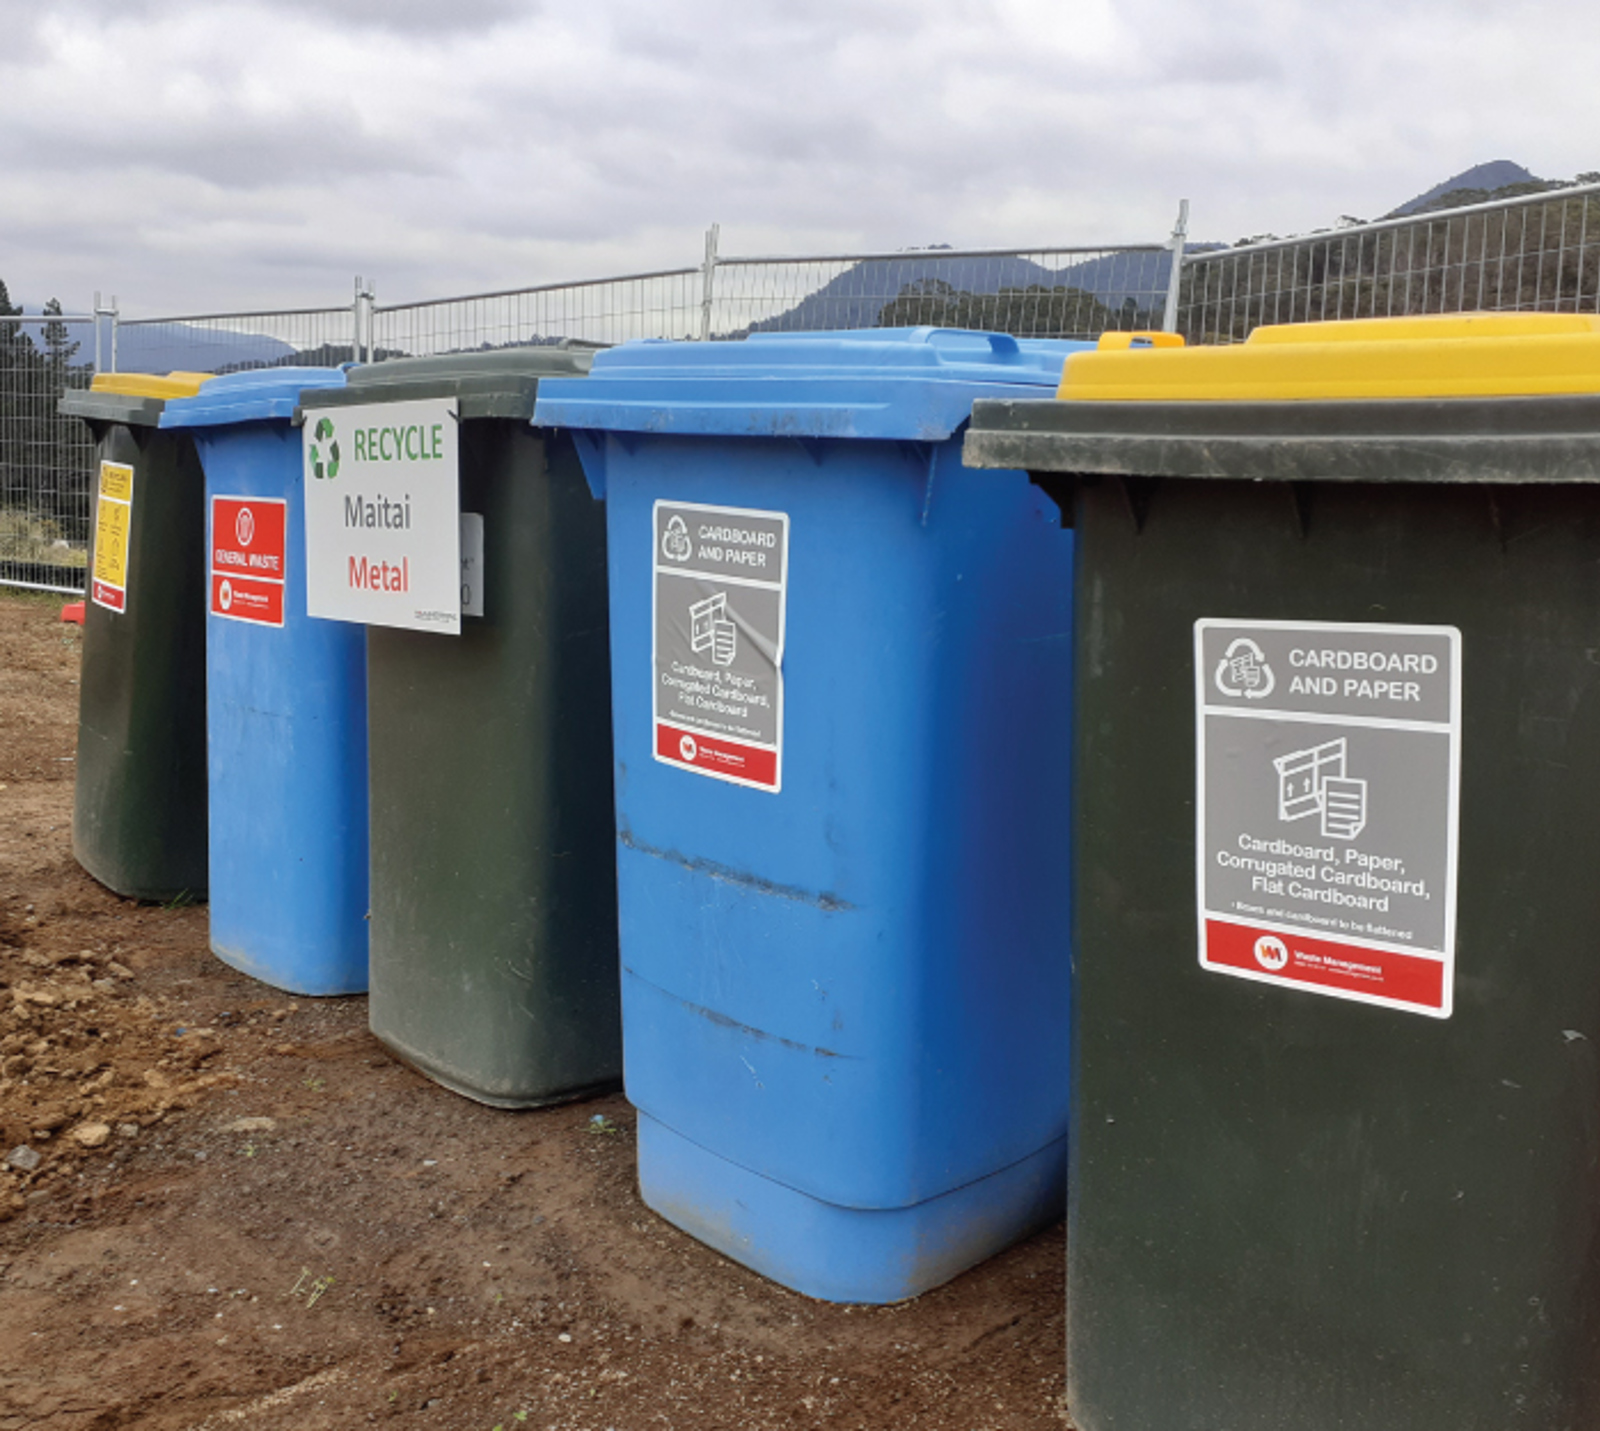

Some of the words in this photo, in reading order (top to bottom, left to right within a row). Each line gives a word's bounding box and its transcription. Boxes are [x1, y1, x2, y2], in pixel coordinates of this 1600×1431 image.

[354, 424, 443, 461] RECYCLE
[344, 494, 411, 529] Maitai
[698, 524, 777, 548] CARDBOARD
[249, 553, 280, 571] WASTE
[349, 556, 408, 591] Metal
[698, 545, 724, 561] AND
[725, 548, 766, 568] PAPER
[1289, 649, 1438, 675] CARDBOARD
[1289, 677, 1338, 696] AND
[1343, 679, 1421, 702] PAPER
[1238, 833, 1341, 866] Cardboard,
[1345, 849, 1406, 875] Paper,
[1216, 850, 1316, 880] Corrugated
[1320, 866, 1431, 900] Cardboard,
[1251, 876, 1285, 896] Flat
[1288, 882, 1390, 912] Cardboard
